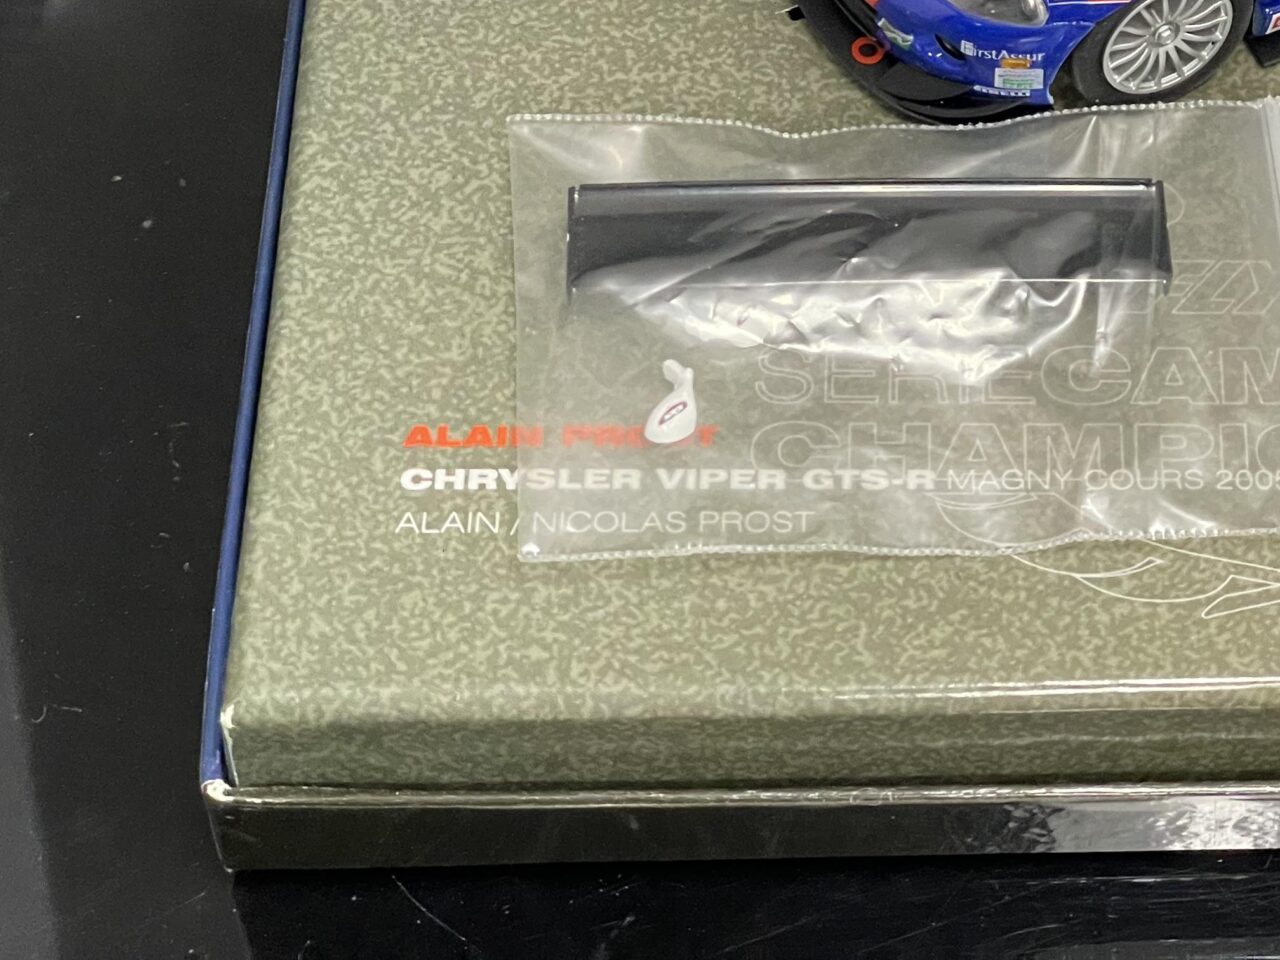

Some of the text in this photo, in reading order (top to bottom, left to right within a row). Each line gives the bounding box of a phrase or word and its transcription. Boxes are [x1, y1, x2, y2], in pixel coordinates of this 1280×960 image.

[402, 424, 545, 449] ALAIN
[400, 468, 641, 491] CHRYSLER
[656, 468, 785, 491] VIPER
[802, 468, 936, 491] GTS-R
[948, 468, 1074, 491] MAGNY
[1084, 468, 1204, 491] COURS
[395, 510, 500, 534] ALAIN
[532, 510, 687, 534] NICOLAS
[698, 510, 815, 534] PROST
